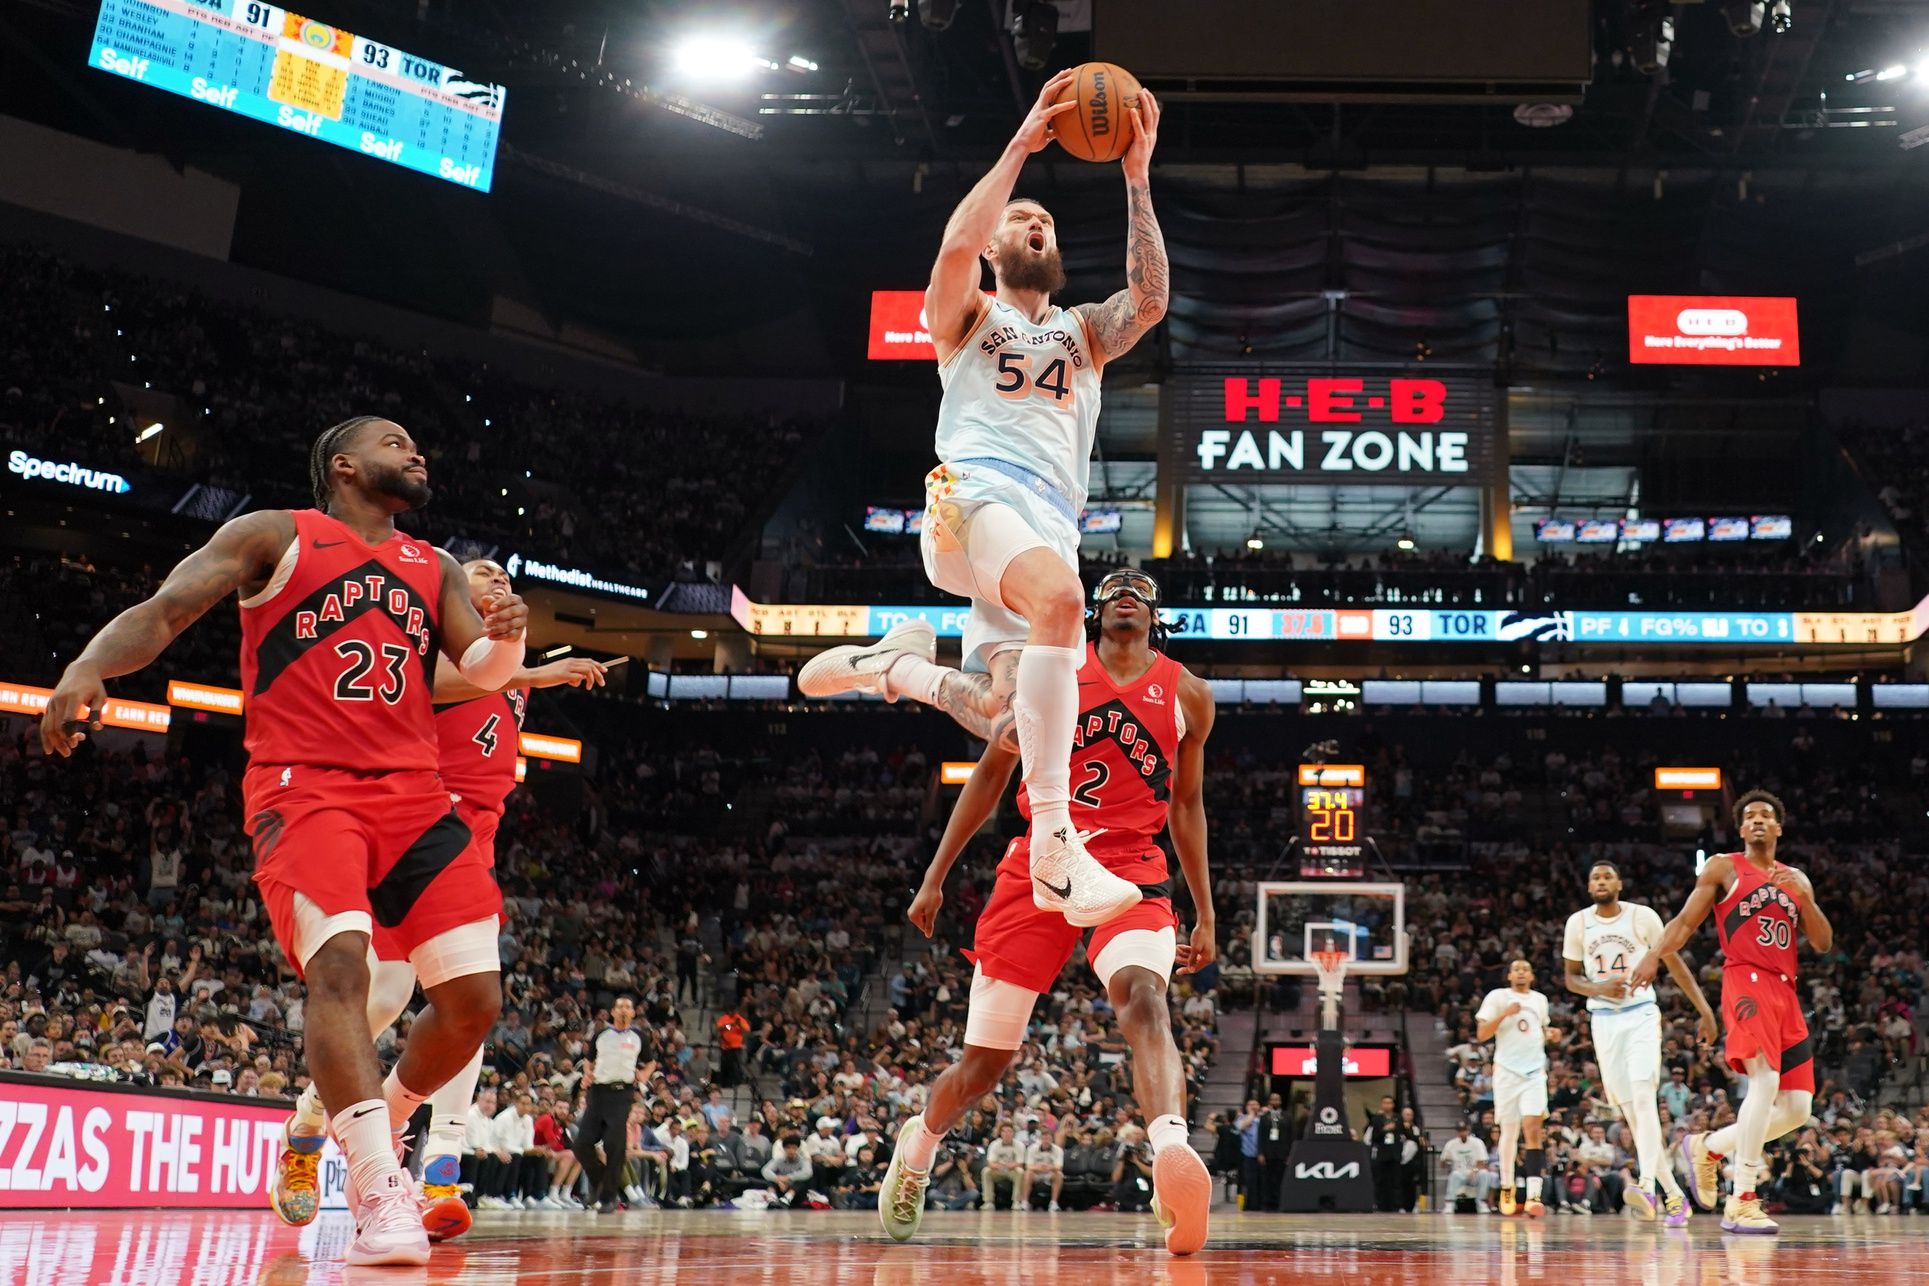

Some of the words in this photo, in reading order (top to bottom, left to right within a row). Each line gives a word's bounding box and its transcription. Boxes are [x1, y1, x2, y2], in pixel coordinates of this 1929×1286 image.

[121, 7, 158, 25] WESLEY
[246, 3, 271, 28] 91
[98, 47, 150, 80] Self
[363, 43, 390, 69] 93
[403, 57, 441, 85] TOR
[190, 76, 239, 109] Self
[1089, 72, 1110, 137] Wilson
[277, 105, 324, 136] Self
[359, 131, 404, 162] Self
[439, 157, 481, 187] Self
[981, 326, 1018, 355] SAN
[1021, 330, 1082, 368] ANTONIO
[995, 352, 1070, 401] 54
[1197, 429, 1305, 471] FAN
[1320, 430, 1469, 472] ZONE
[8, 450, 124, 494] Spectrum
[525, 559, 593, 588] Methodist
[296, 574, 430, 655] RAPTORS
[1229, 614, 1248, 635] 91
[1389, 615, 1413, 635] 93
[1438, 614, 1488, 635] TOR
[1580, 617, 1612, 635] PF
[1640, 618, 1698, 636] FG%
[1736, 619, 1769, 636] TO
[334, 638, 410, 705] 23
[115, 706, 145, 722] EARN
[472, 713, 501, 758] 4
[1073, 710, 1157, 776] APTORS
[1071, 760, 1110, 809] 2
[1307, 791, 1348, 810] 37.4
[1310, 810, 1354, 841] 20
[1319, 846, 1362, 856] TISSOT
[1756, 915, 1792, 950] 30
[1595, 953, 1628, 973] 14
[1518, 1018, 1529, 1033] 0
[125, 1110, 204, 1194] THE
[325, 1159, 348, 1197] Piz
